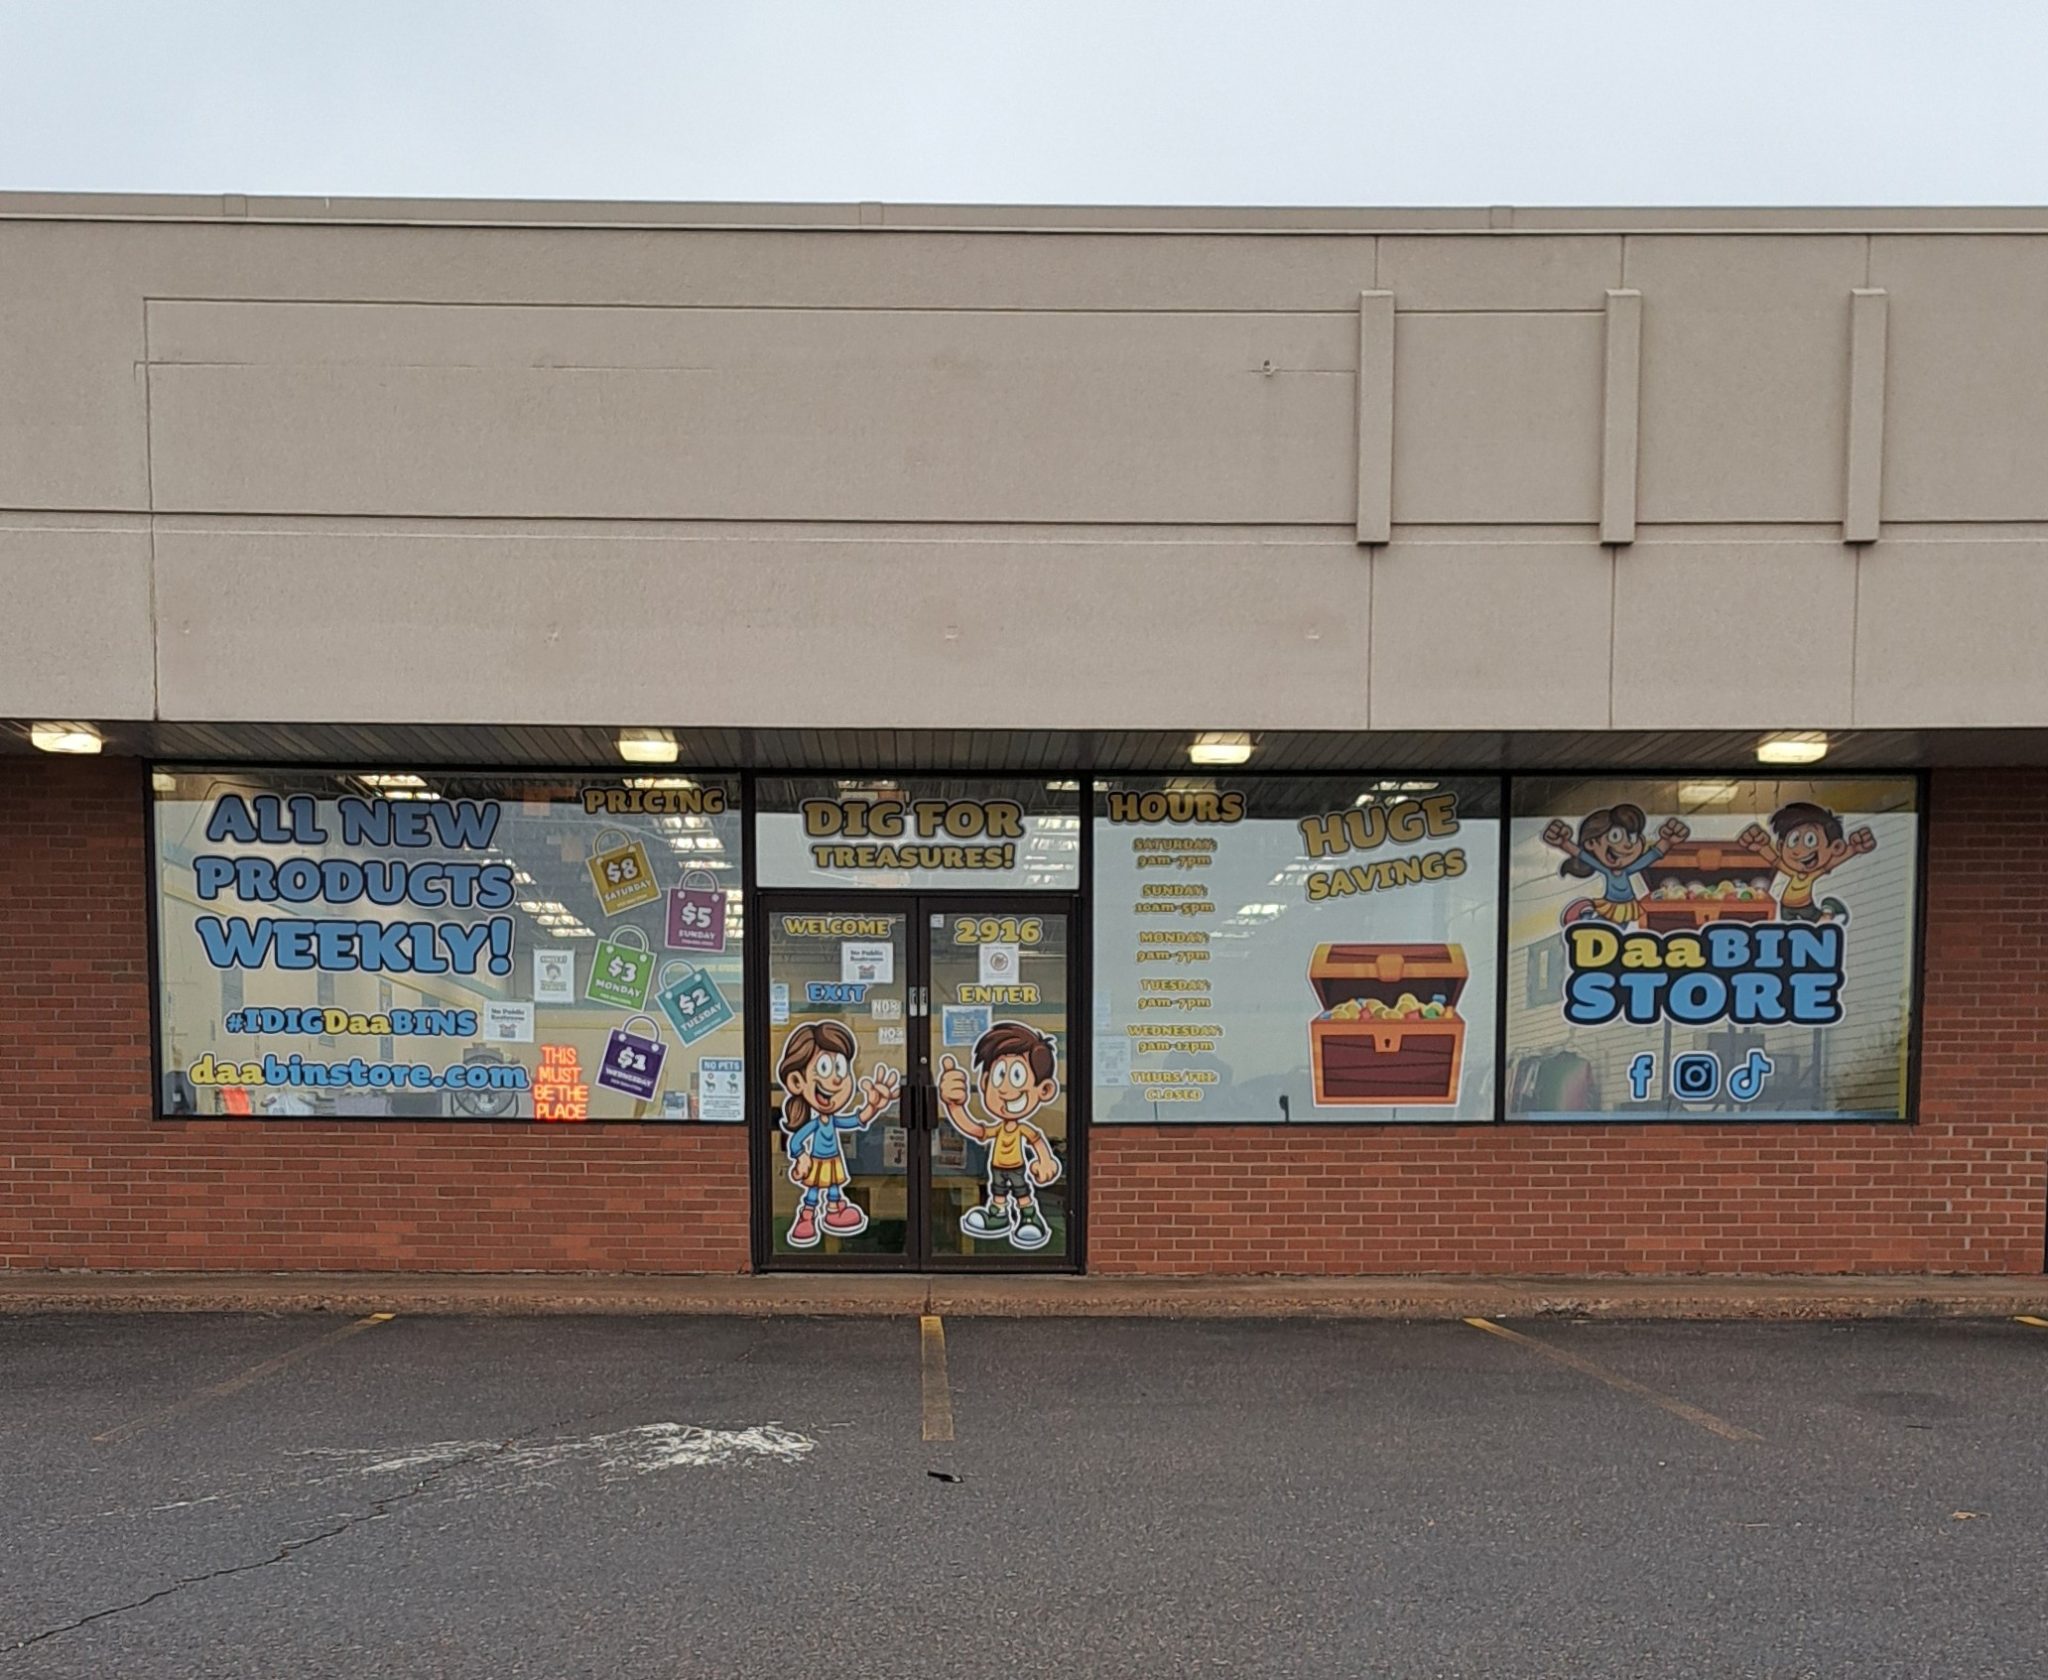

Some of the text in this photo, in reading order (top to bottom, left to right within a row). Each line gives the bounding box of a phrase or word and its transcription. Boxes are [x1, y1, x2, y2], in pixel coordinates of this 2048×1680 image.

[582, 788, 725, 815] PRICING
[1108, 792, 1244, 823] HOURS
[207, 794, 500, 849] ALL NEW
[802, 801, 1024, 838] DIG FOR
[1301, 794, 1460, 857] HUGE
[812, 844, 1016, 869] TREASURES!
[194, 856, 514, 907] PRODUCTS
[607, 858, 638, 883] $8
[1307, 850, 1467, 901] SAVINGS
[605, 880, 652, 901] SATURDAY
[1142, 884, 1208, 897] SUNDAY:
[681, 902, 713, 928] $5
[785, 918, 890, 936] WELCOME
[679, 929, 716, 940] SUNDAY
[956, 919, 1041, 943] 2916
[1139, 931, 1210, 944] MONDAY:
[196, 917, 513, 976] WEEKLY!
[1567, 924, 1841, 971] DaaBIN
[608, 956, 637, 982] $3
[595, 979, 642, 998] MONDAY
[807, 984, 867, 1003] EXIT
[959, 985, 1039, 1004] ENTER
[1567, 970, 1841, 1023] STORE
[679, 988, 711, 1015] $2
[226, 1008, 478, 1036] #IDIGDaaBINS
[680, 1002, 722, 1031] TUESDAY
[541, 1045, 577, 1065] THIS
[617, 1046, 647, 1071] $1
[704, 1061, 717, 1070] NO
[189, 1054, 530, 1088] daabinstore.com
[538, 1066, 583, 1084] MUST
[1146, 1088, 1202, 1101] CLOSED
[536, 1102, 588, 1120] PLACE
